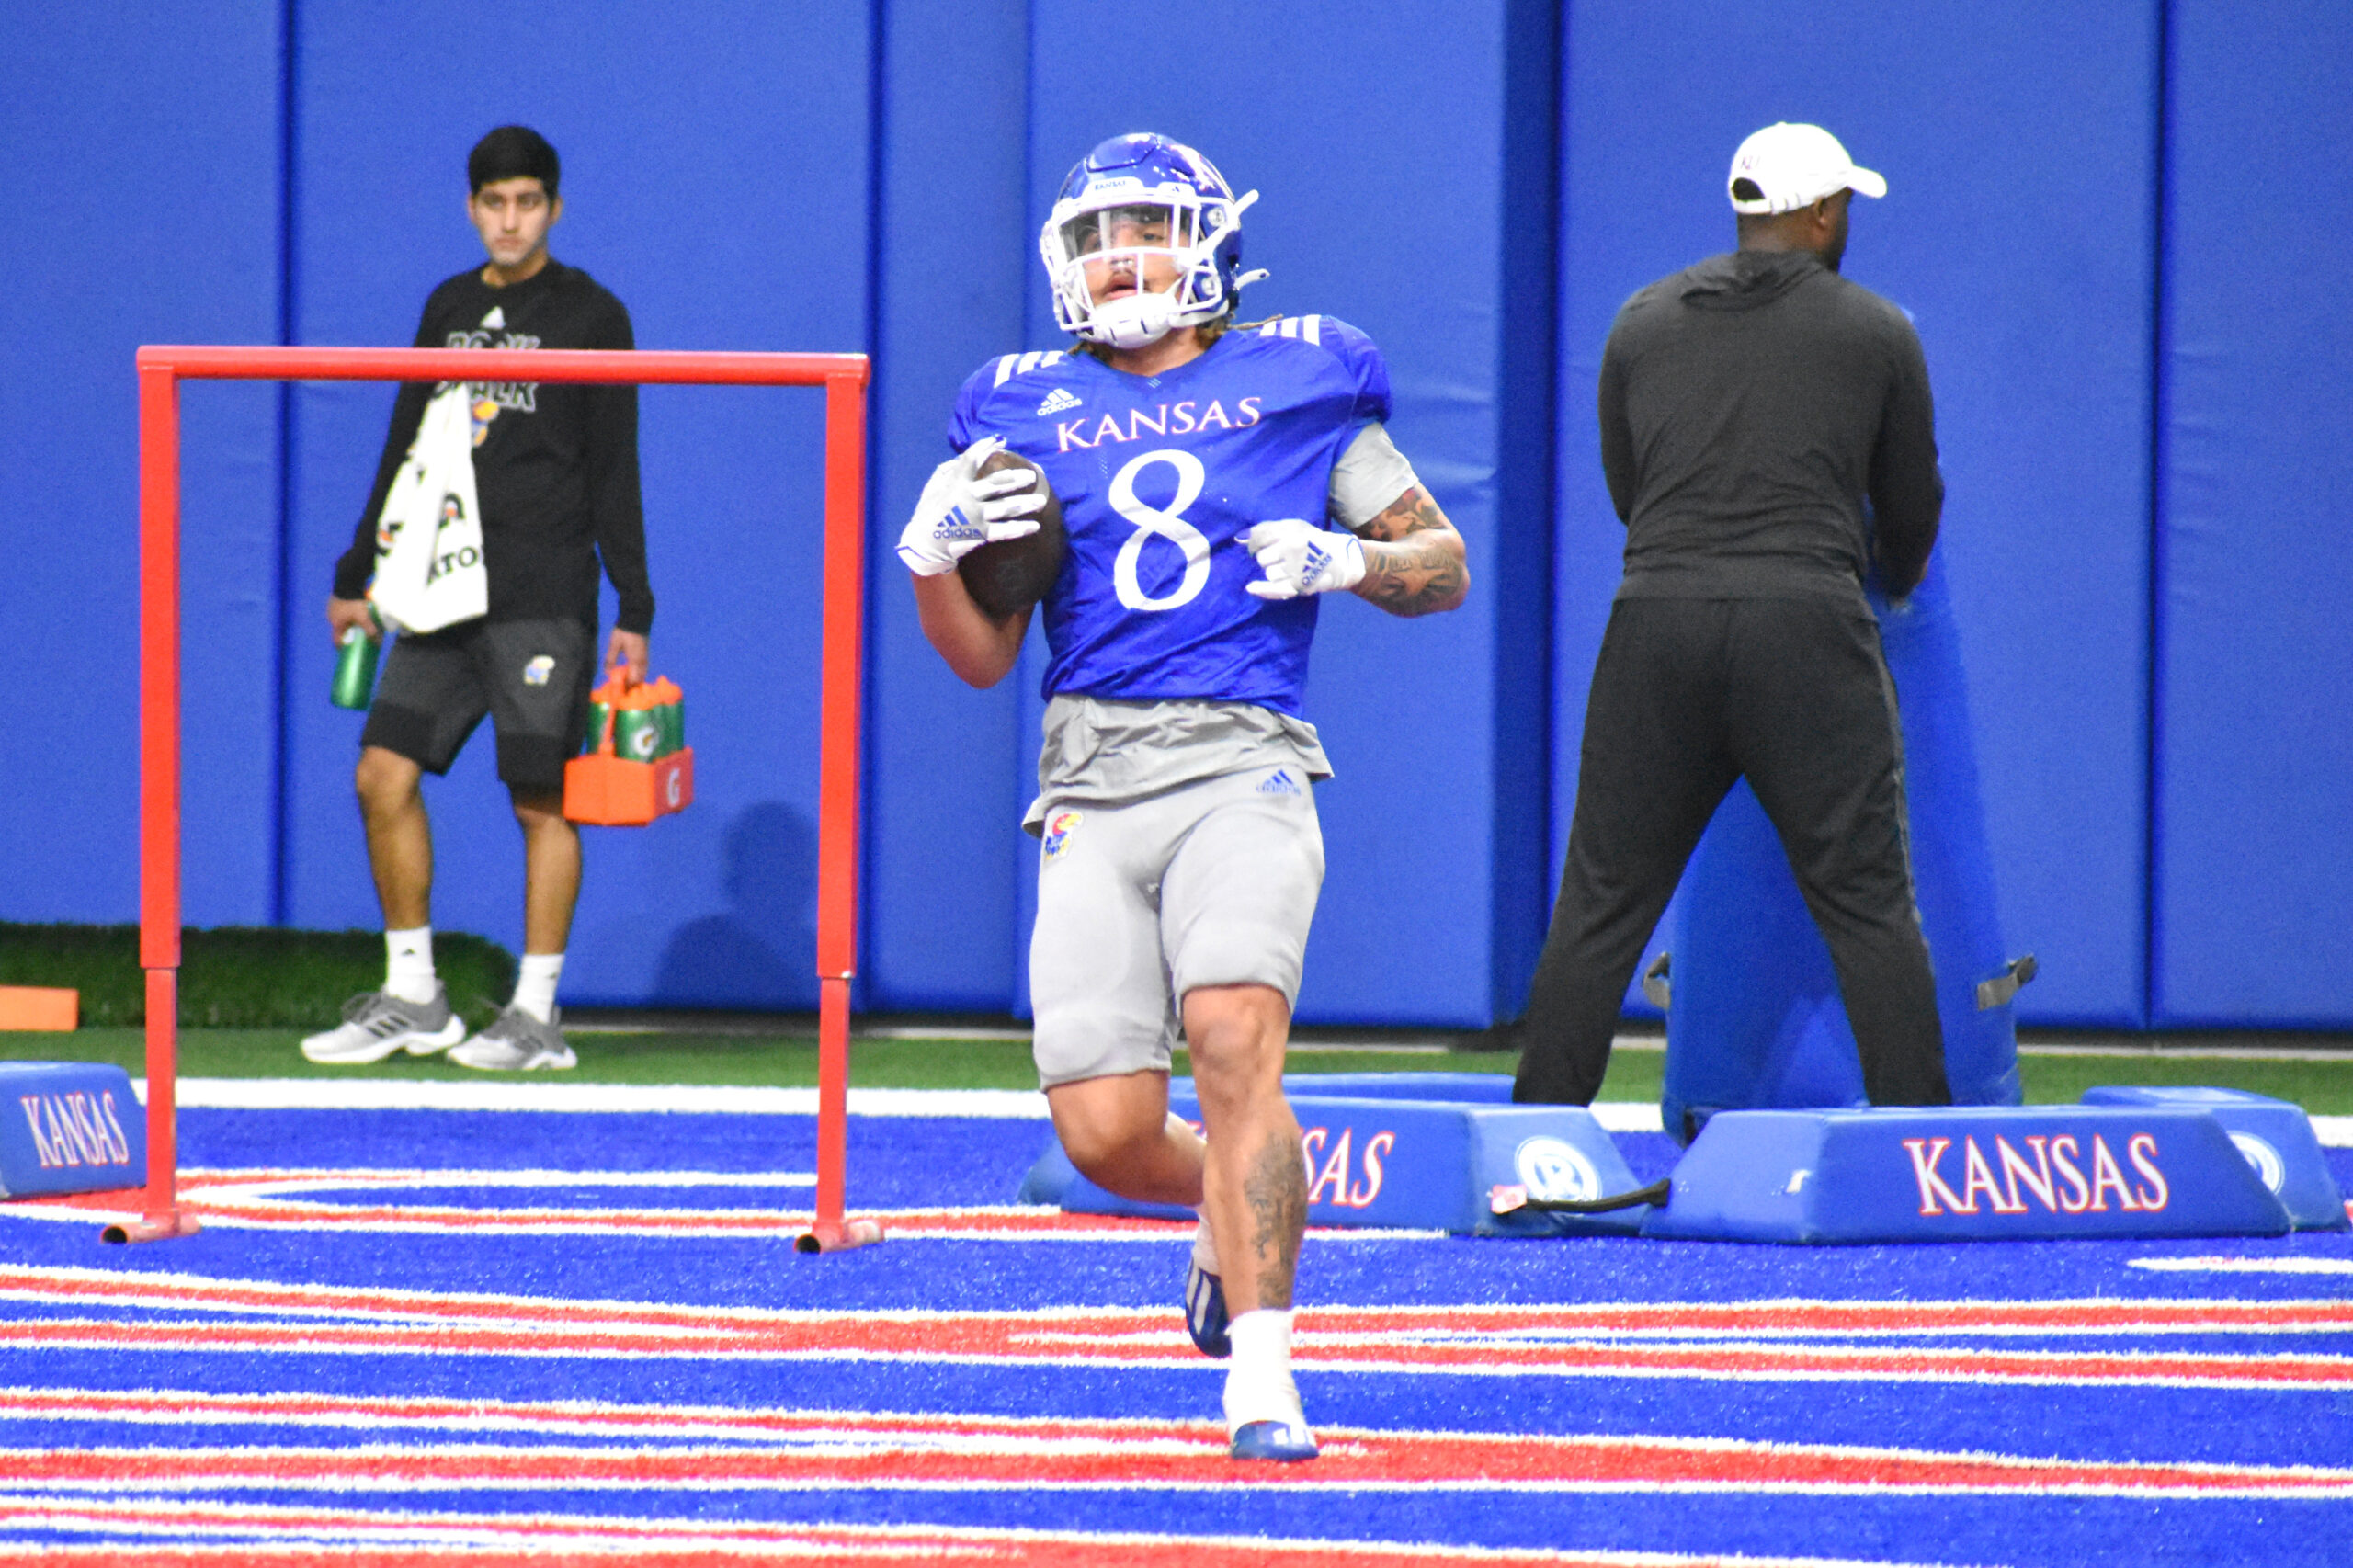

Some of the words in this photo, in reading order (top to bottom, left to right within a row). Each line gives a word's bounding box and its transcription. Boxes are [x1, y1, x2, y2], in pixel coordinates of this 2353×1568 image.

[1037, 397, 1083, 416] adidas
[1056, 396, 1262, 453] KANSAS
[932, 526, 979, 540] adidas
[1108, 449, 1211, 612] 8
[632, 726, 655, 756] G
[666, 767, 681, 808] G
[20, 1089, 130, 1168] KANSAS
[1902, 1133, 2169, 1216] KANSAS
